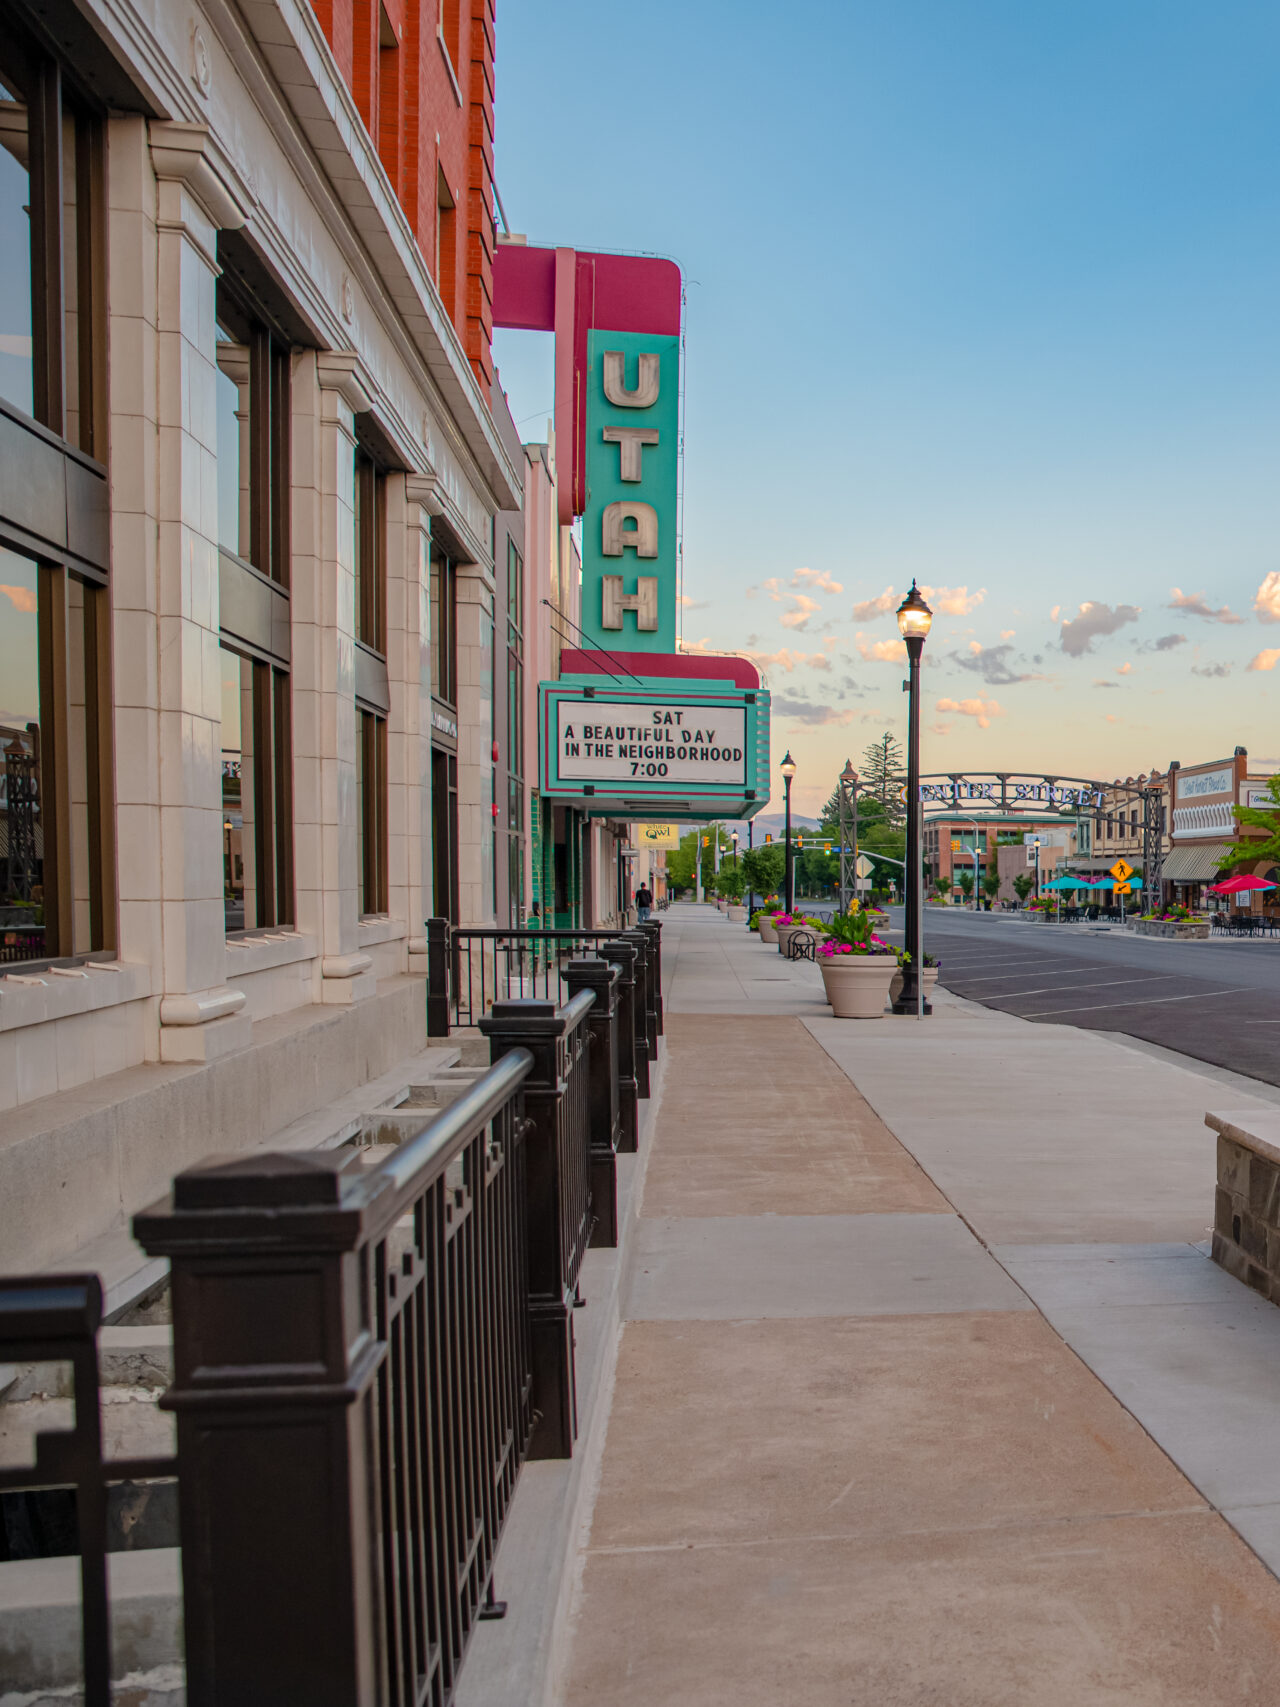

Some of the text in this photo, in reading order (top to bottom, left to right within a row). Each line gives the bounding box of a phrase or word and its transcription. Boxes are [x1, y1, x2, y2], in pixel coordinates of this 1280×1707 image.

[602, 351, 660, 632] UTAH
[653, 711, 683, 725] SAT
[565, 725, 715, 744] A BEAUTIFUL DAY
[565, 742, 742, 762] IN THE NEIGHBORHOOD
[630, 762, 668, 777] 7:00
[1016, 784, 1108, 808] STREET
